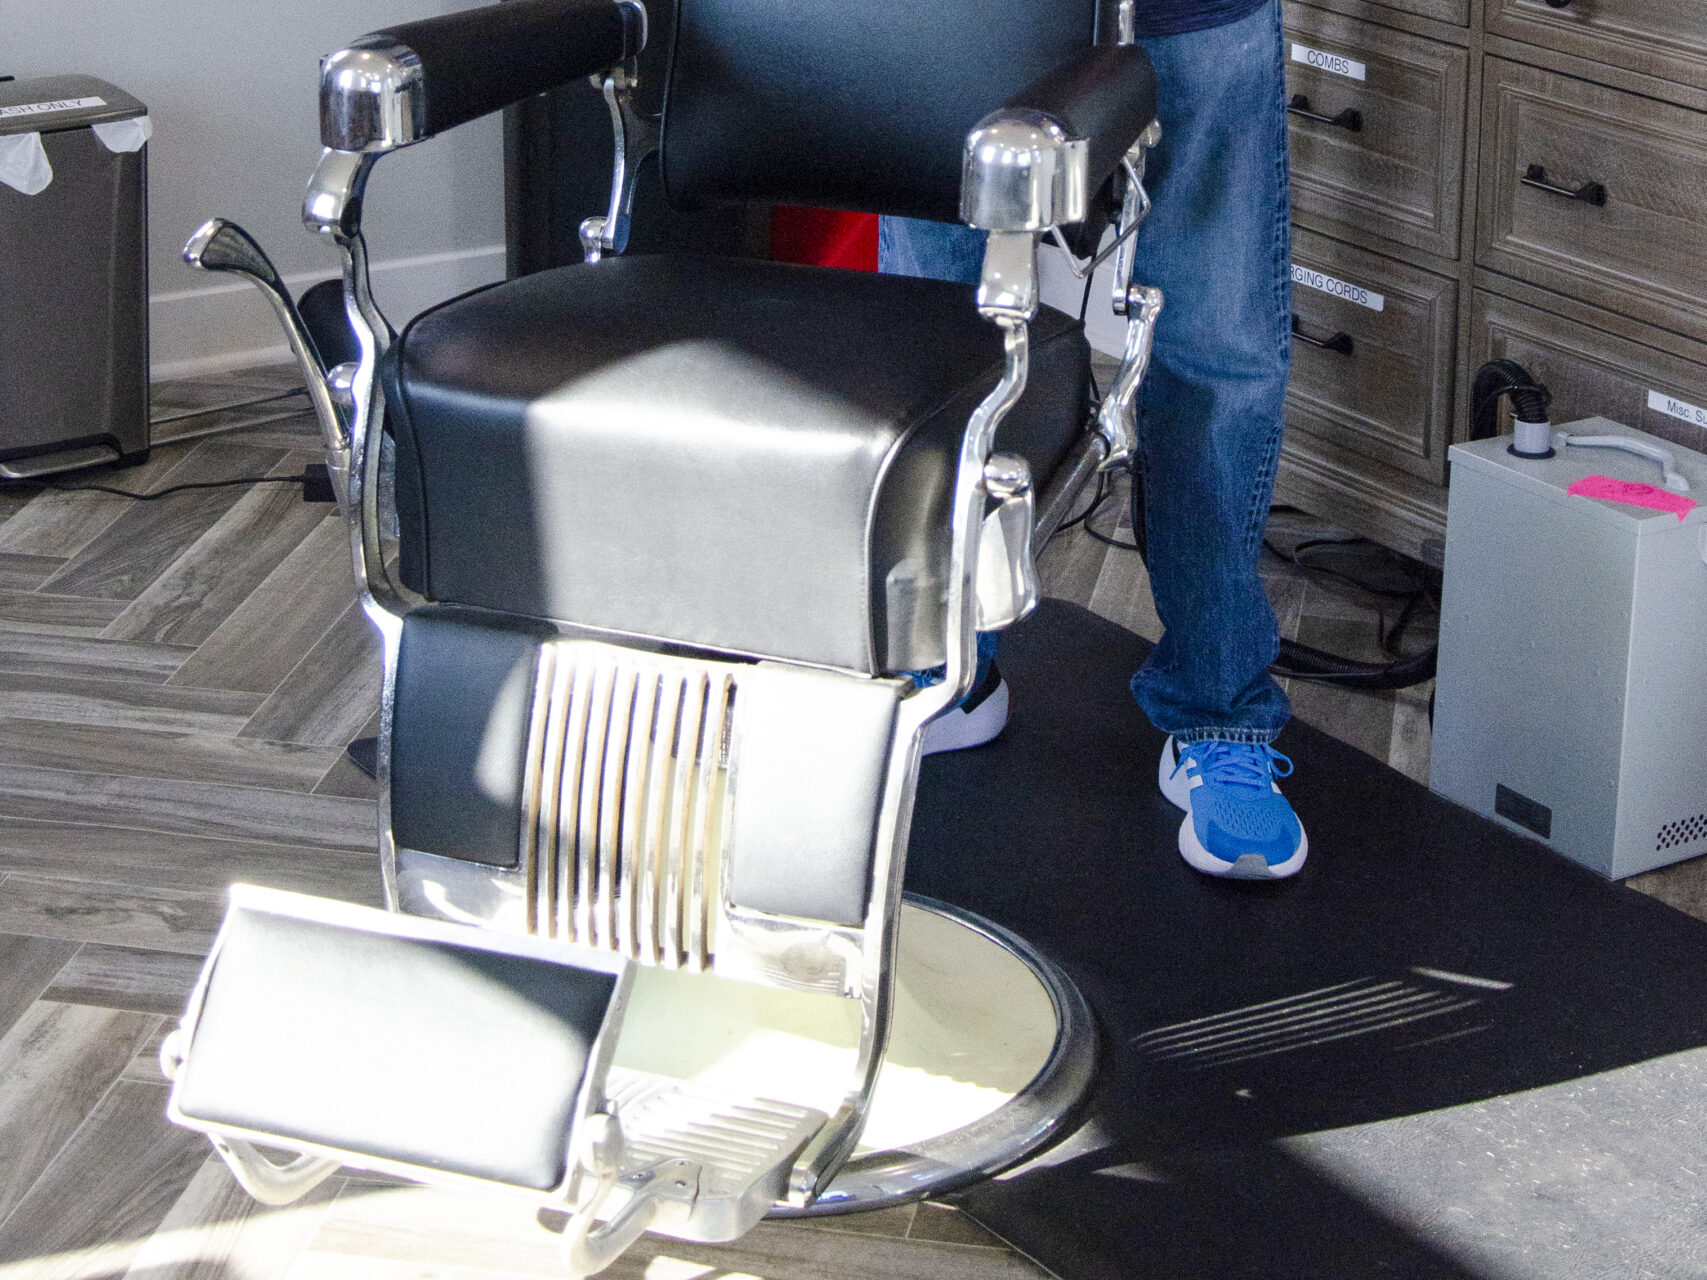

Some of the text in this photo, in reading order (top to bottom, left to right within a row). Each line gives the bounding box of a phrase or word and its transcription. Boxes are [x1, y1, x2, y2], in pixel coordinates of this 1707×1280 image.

[1307, 50, 1349, 74] COMBS
[37, 99, 82, 112] ONLY
[1326, 278, 1368, 304] CORDS
[1667, 399, 1692, 419] Misc.
